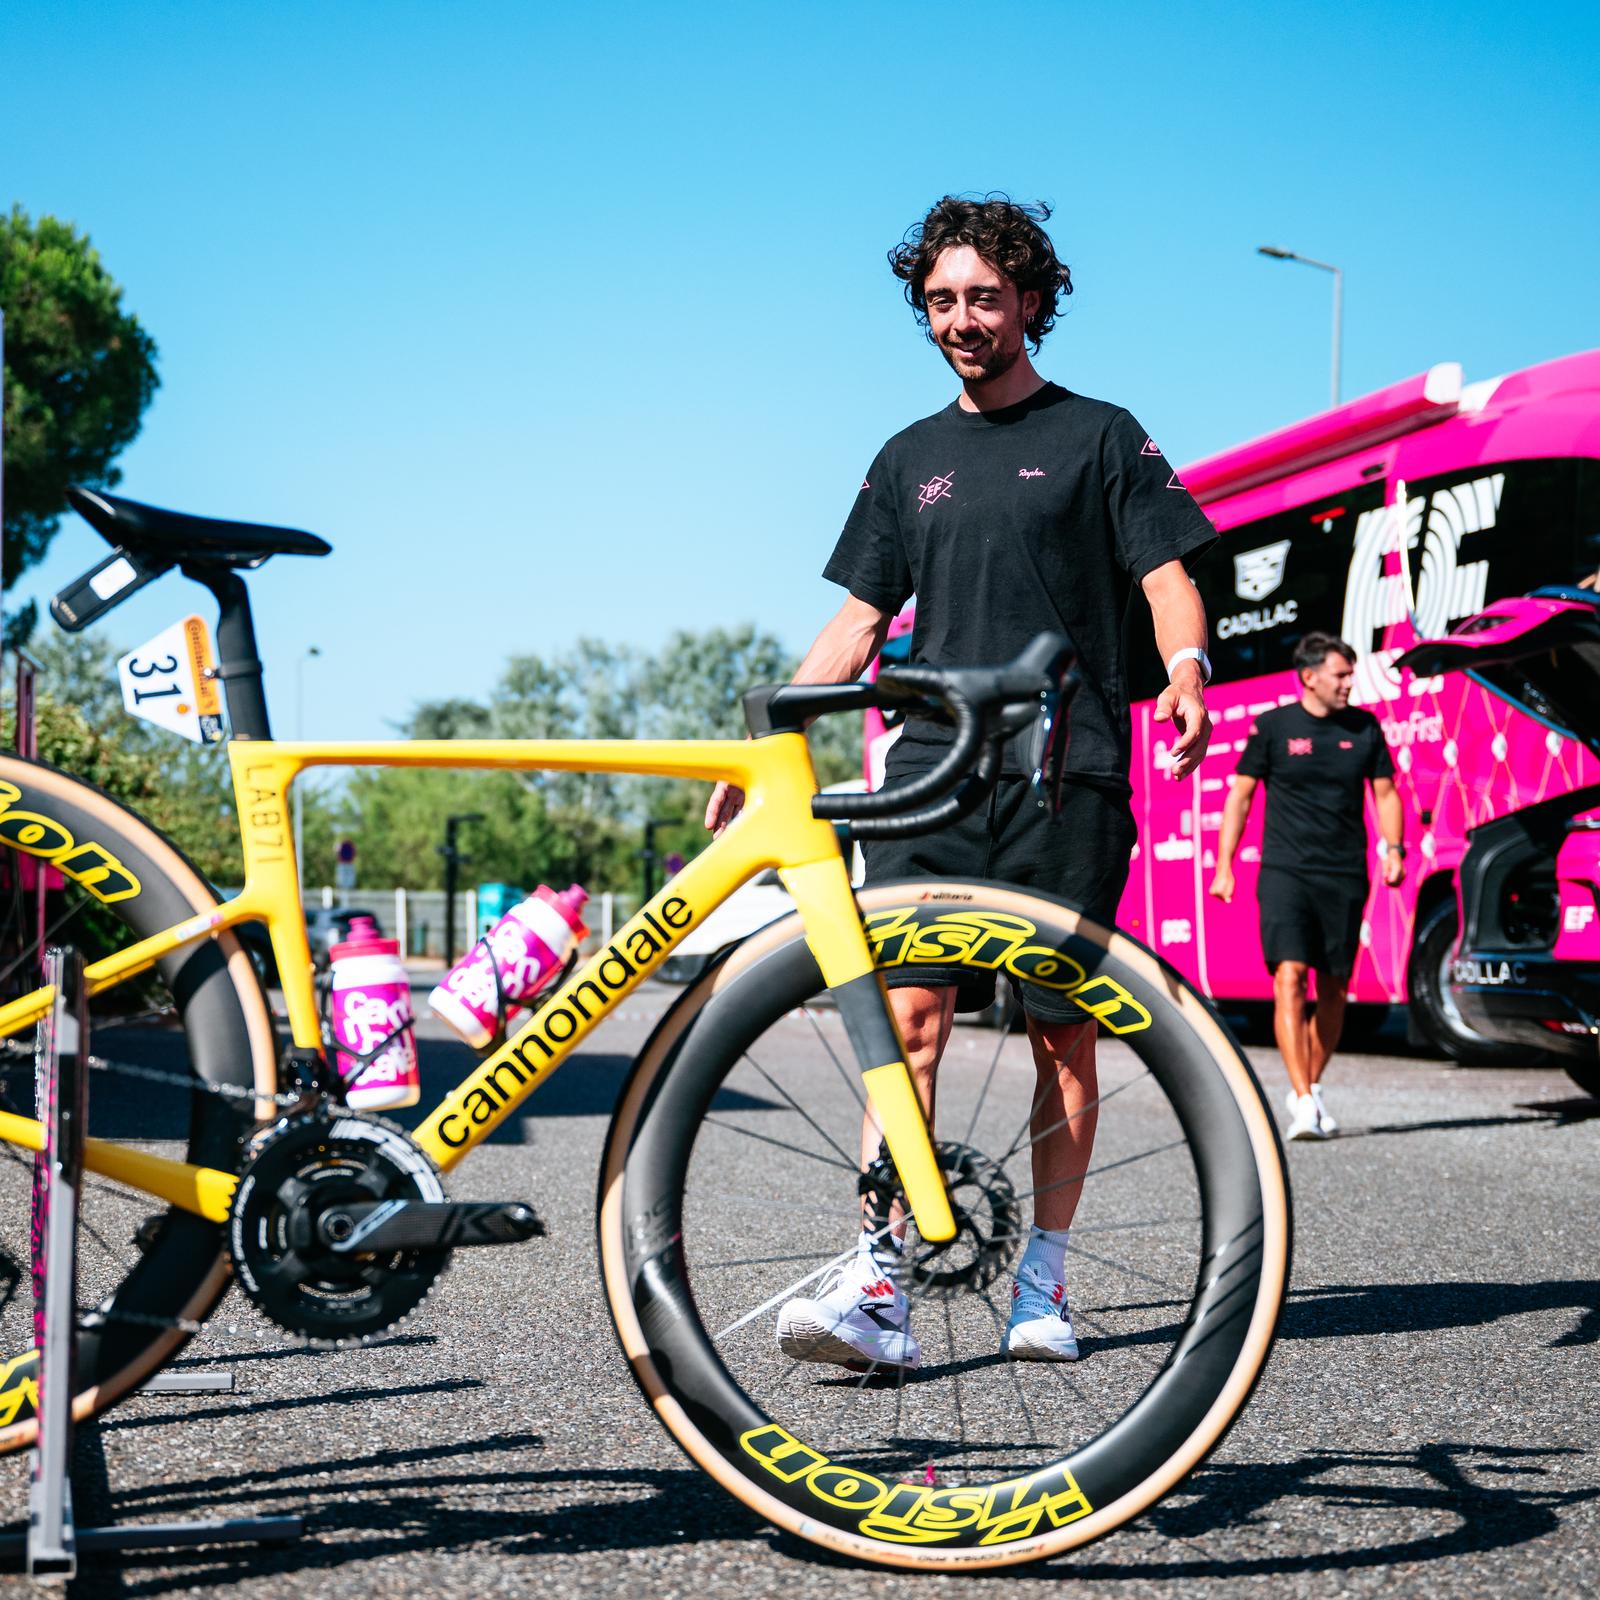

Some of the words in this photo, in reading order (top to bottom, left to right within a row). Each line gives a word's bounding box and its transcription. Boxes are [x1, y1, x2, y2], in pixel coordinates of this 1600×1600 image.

[926, 482, 943, 499] EF
[1217, 600, 1298, 639] CADILLAC
[129, 655, 182, 705] 31
[246, 763, 285, 864] LAB71
[1564, 905, 1595, 930] EF
[437, 896, 693, 1148] cannondale
[740, 1423, 1093, 1545] Vision
